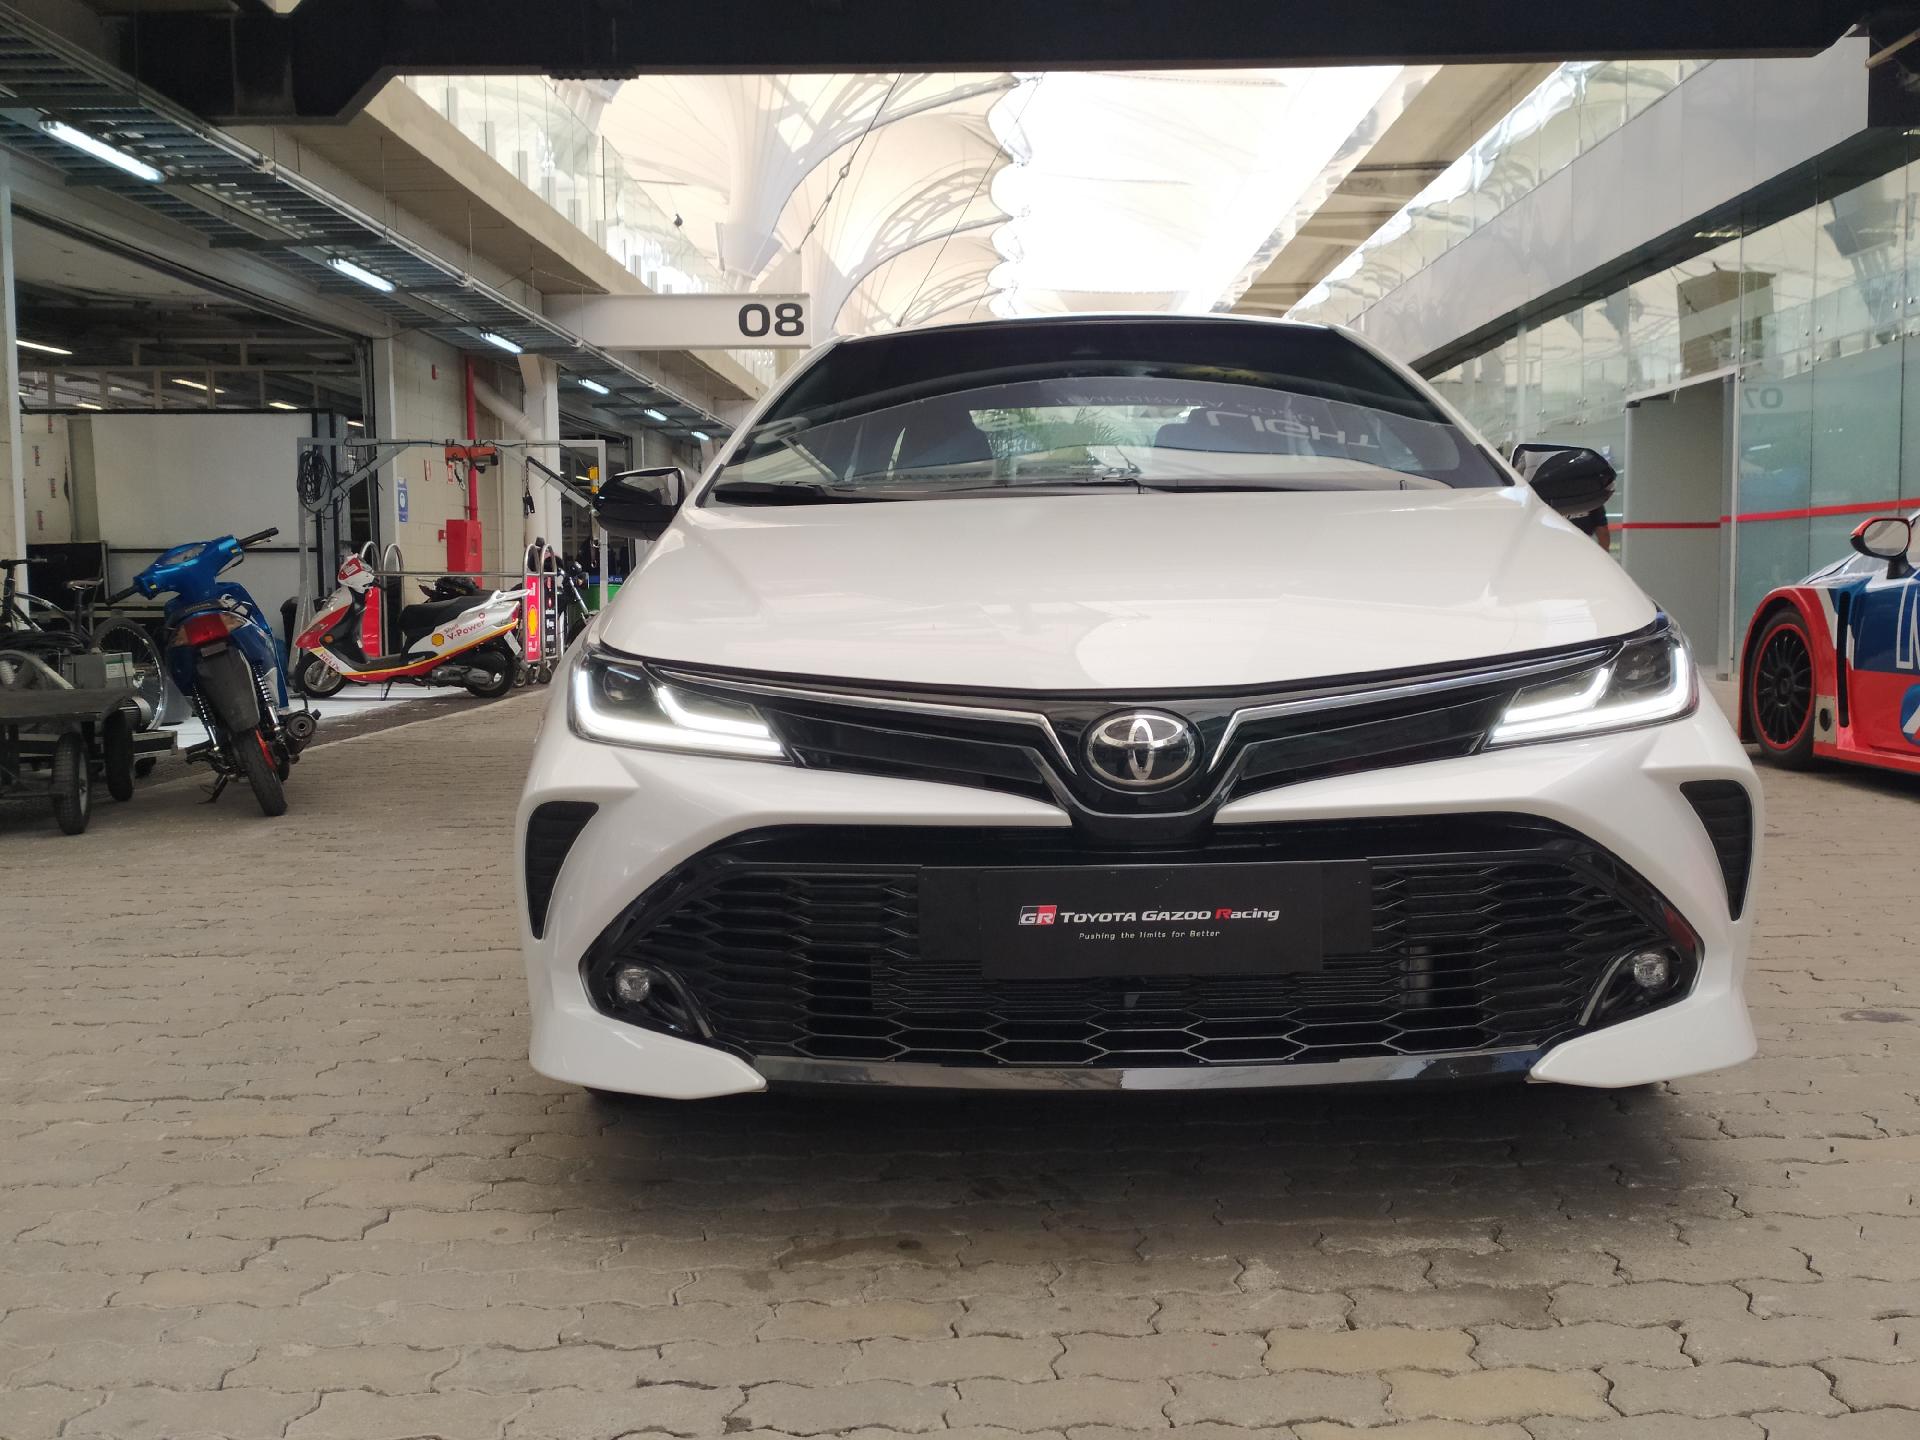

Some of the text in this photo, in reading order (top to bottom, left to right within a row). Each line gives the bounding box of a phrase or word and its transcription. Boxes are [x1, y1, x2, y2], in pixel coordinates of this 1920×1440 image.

[739, 303, 805, 337] 08
[447, 620, 485, 640] V-Power
[1020, 907, 1281, 925] GR TOYOTA GAZOO Racing
[1079, 929, 1221, 941] Pushing the limits for Better
